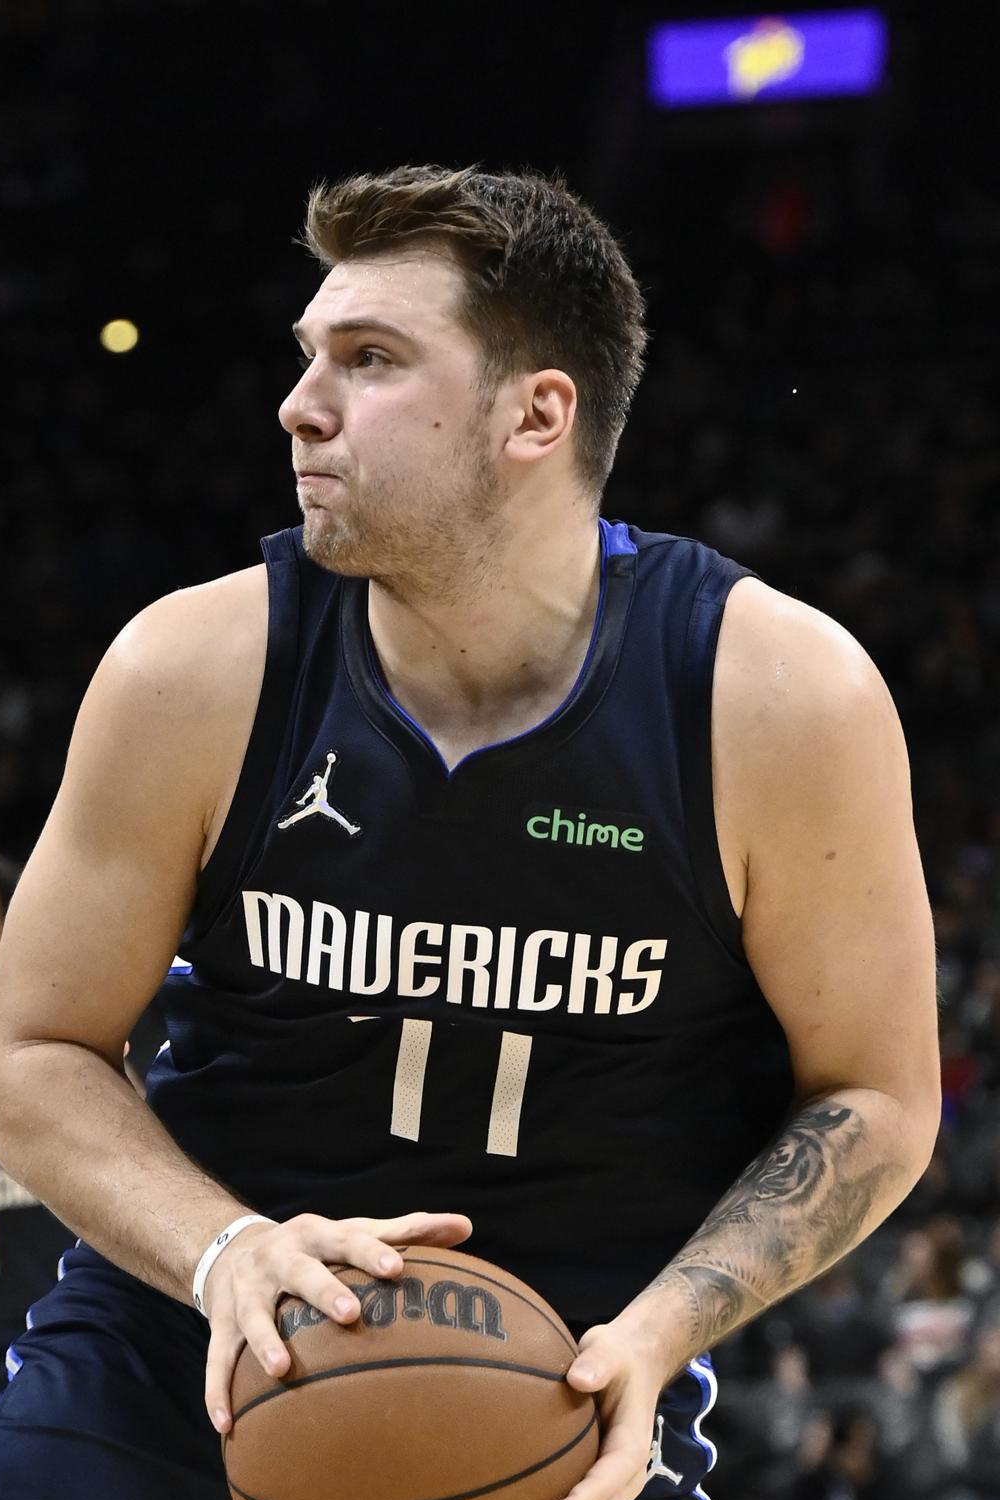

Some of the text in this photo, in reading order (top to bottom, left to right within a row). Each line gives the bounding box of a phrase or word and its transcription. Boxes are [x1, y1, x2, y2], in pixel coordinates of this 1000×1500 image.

[527, 808, 645, 852] chime
[241, 890, 668, 1015] MAVERICKS
[390, 1018, 533, 1157] 11
